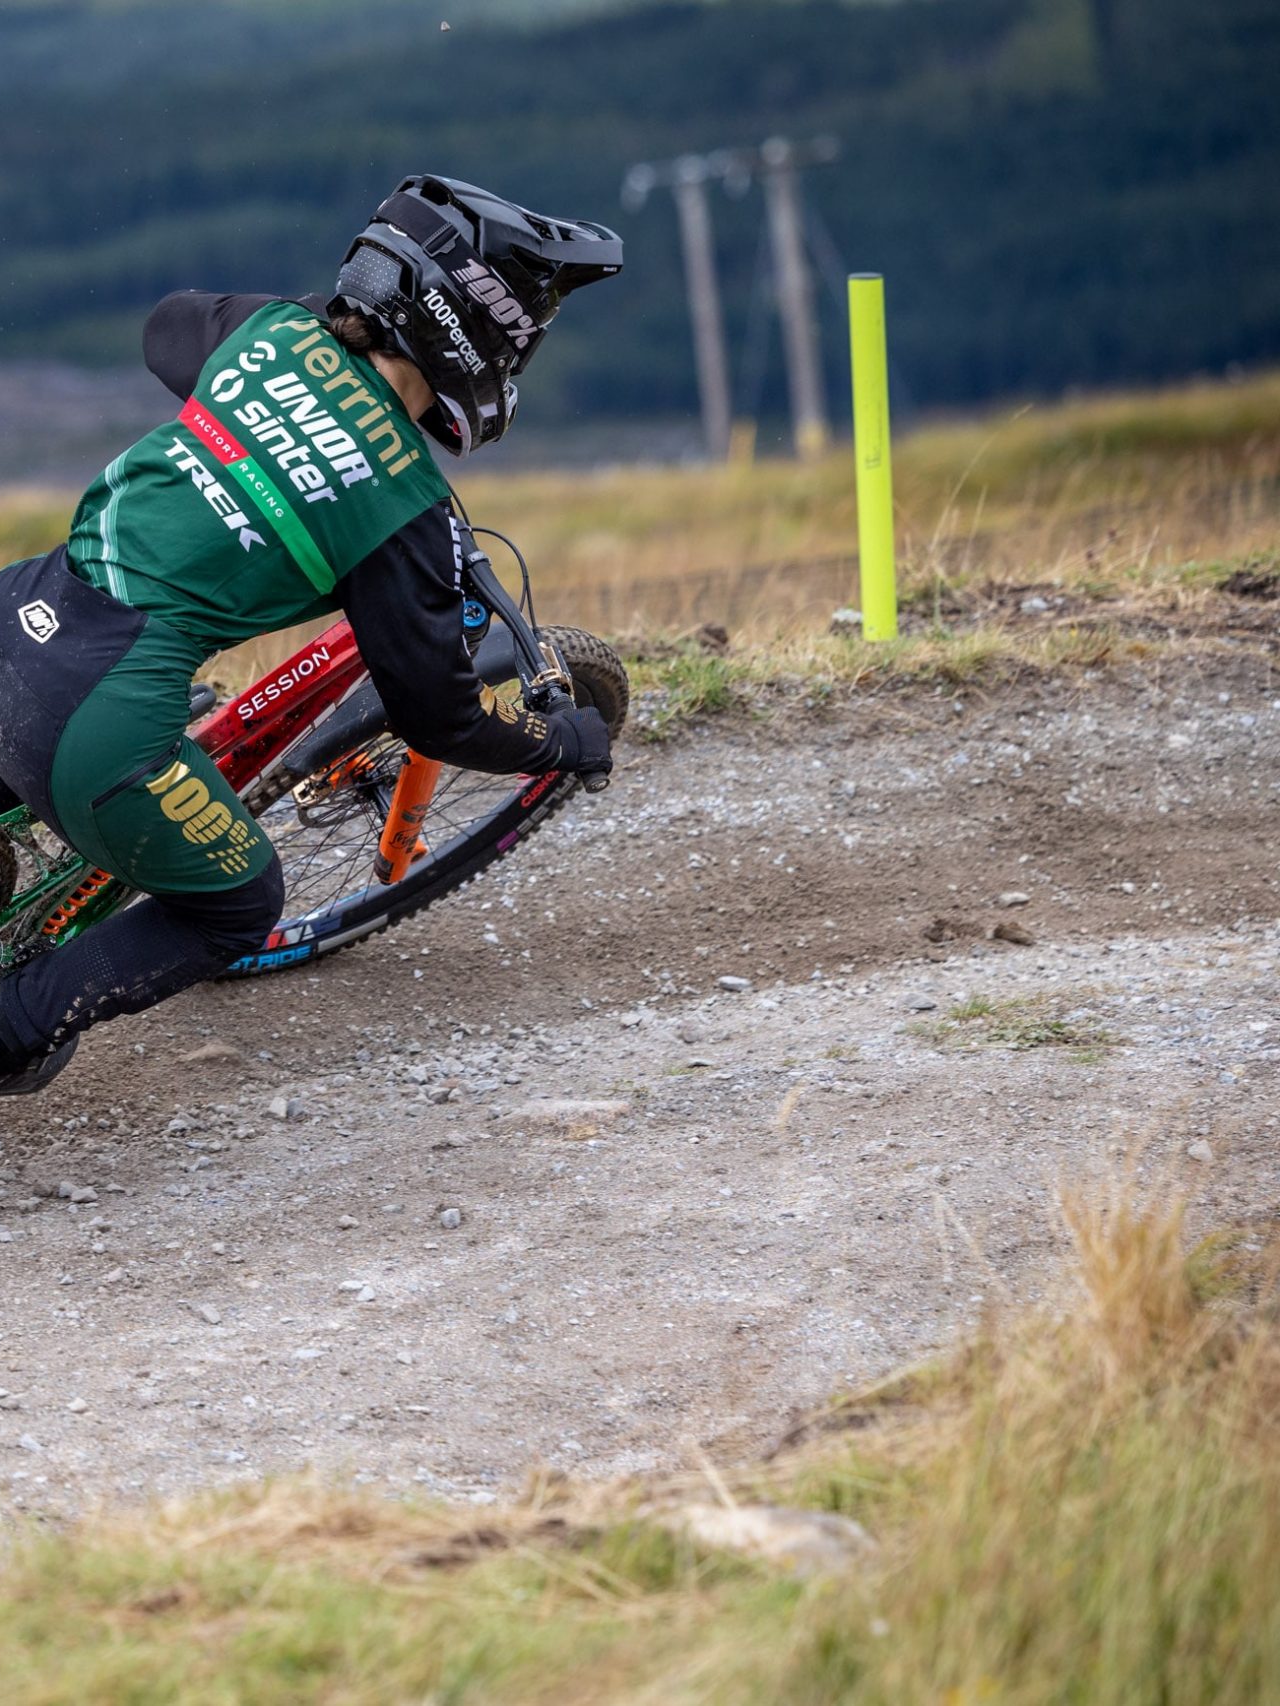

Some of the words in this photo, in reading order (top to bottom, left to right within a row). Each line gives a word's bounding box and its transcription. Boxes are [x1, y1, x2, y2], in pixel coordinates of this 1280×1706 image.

[423, 287, 487, 375] 100Percent
[451, 258, 538, 349] 100%
[193, 413, 239, 460] FACTORY
[238, 461, 285, 518] RACING
[233, 400, 339, 504] sinter
[262, 371, 374, 489] UNIOR
[164, 436, 268, 553] TREK
[237, 646, 330, 720] SESSION
[257, 944, 312, 970] RIDE
